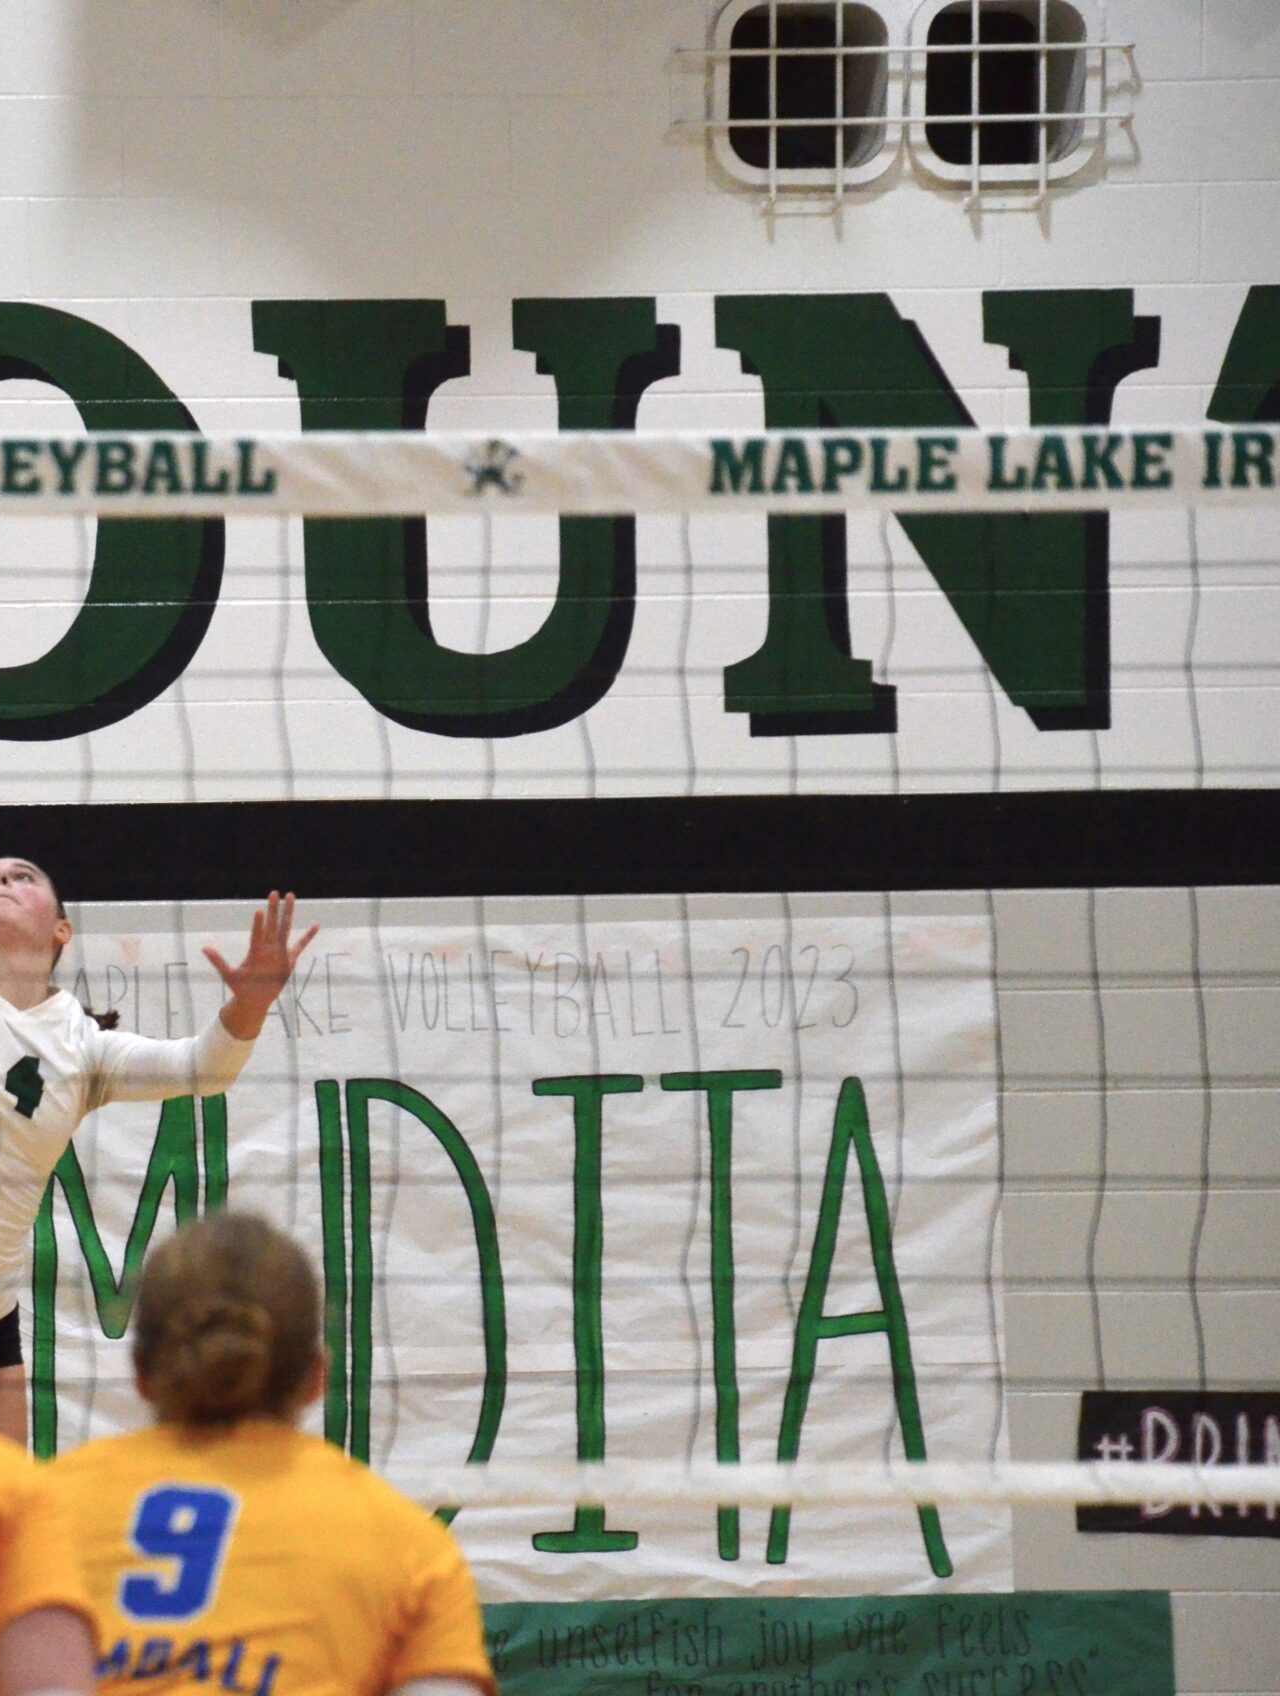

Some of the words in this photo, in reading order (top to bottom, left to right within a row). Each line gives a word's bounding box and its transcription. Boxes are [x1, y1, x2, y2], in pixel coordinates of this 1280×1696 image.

[709, 435, 959, 495] MAPLE
[986, 432, 1173, 491] LAKE
[72, 961, 189, 1040] APLE
[387, 946, 682, 1039] VOLLEYBALL
[721, 943, 860, 1031] 2023
[117, 1480, 242, 1626] 9
[538, 1607, 723, 1670] unselfish
[750, 1609, 813, 1678] joy
[833, 1609, 908, 1656] one
[937, 1601, 1033, 1659] feels
